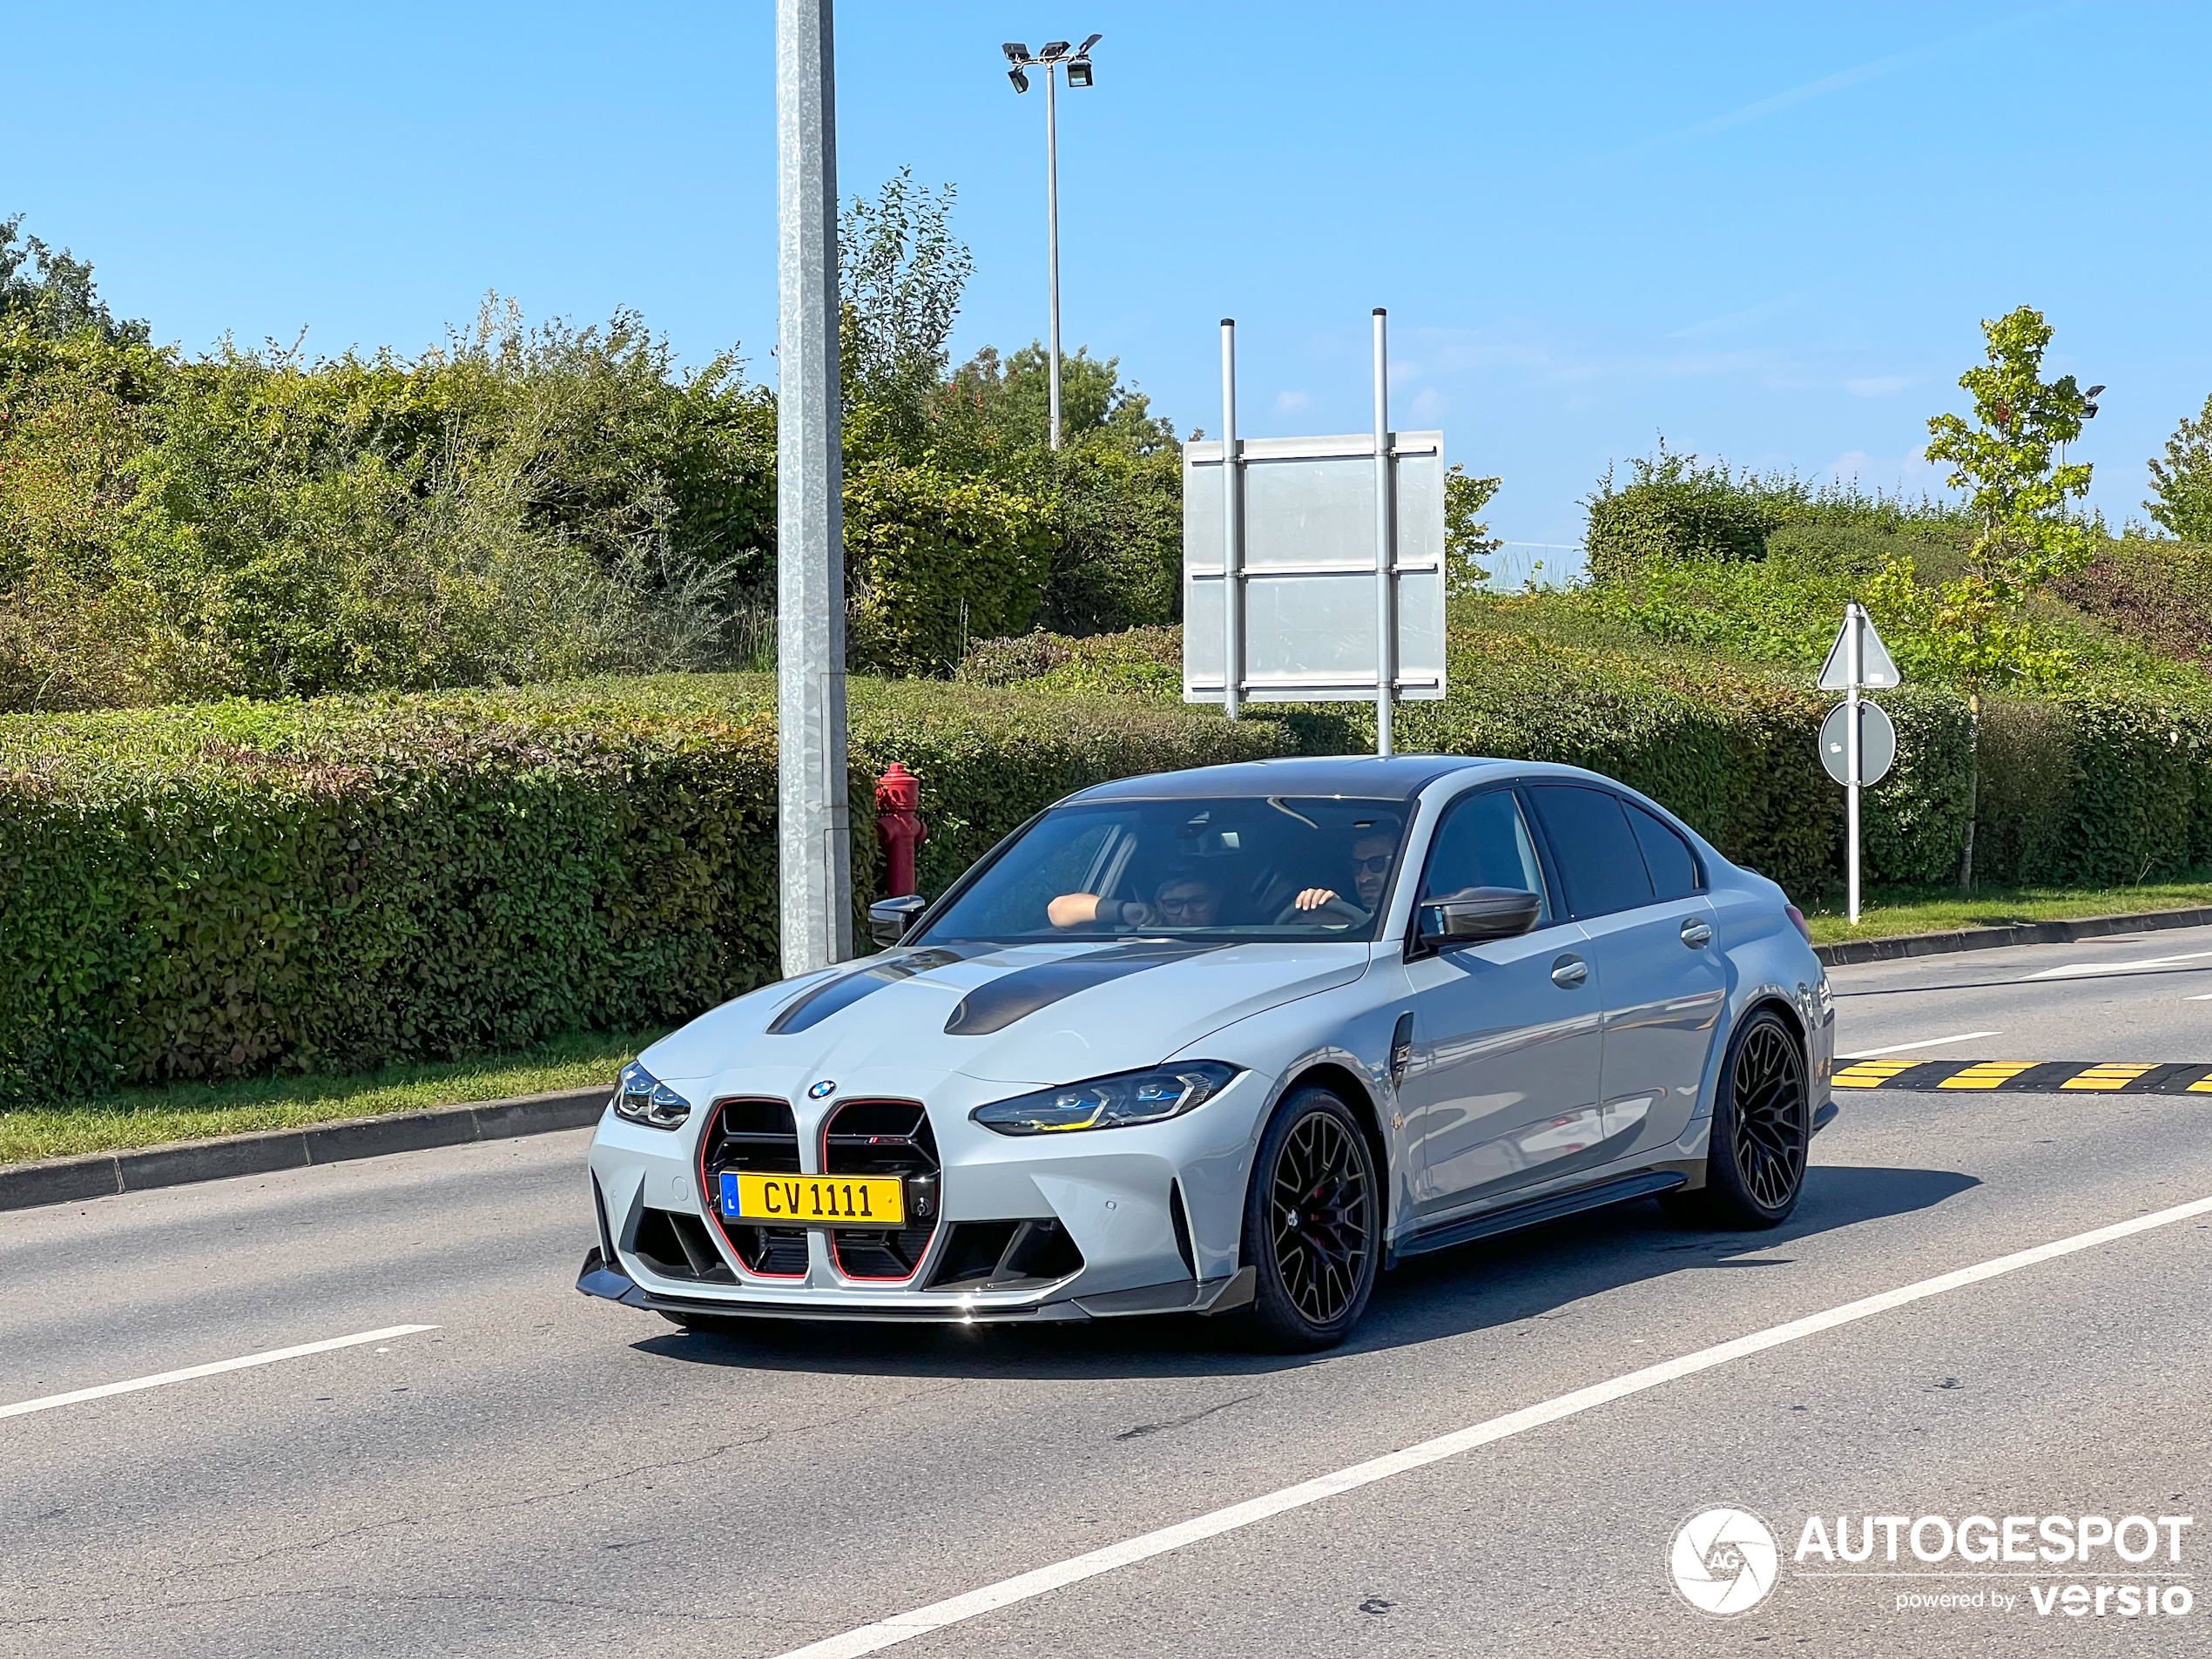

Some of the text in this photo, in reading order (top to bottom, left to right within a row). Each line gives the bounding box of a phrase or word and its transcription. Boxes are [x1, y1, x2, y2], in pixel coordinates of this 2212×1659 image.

[728, 1198, 735, 1210] L
[764, 1182, 873, 1217] CV 1111
